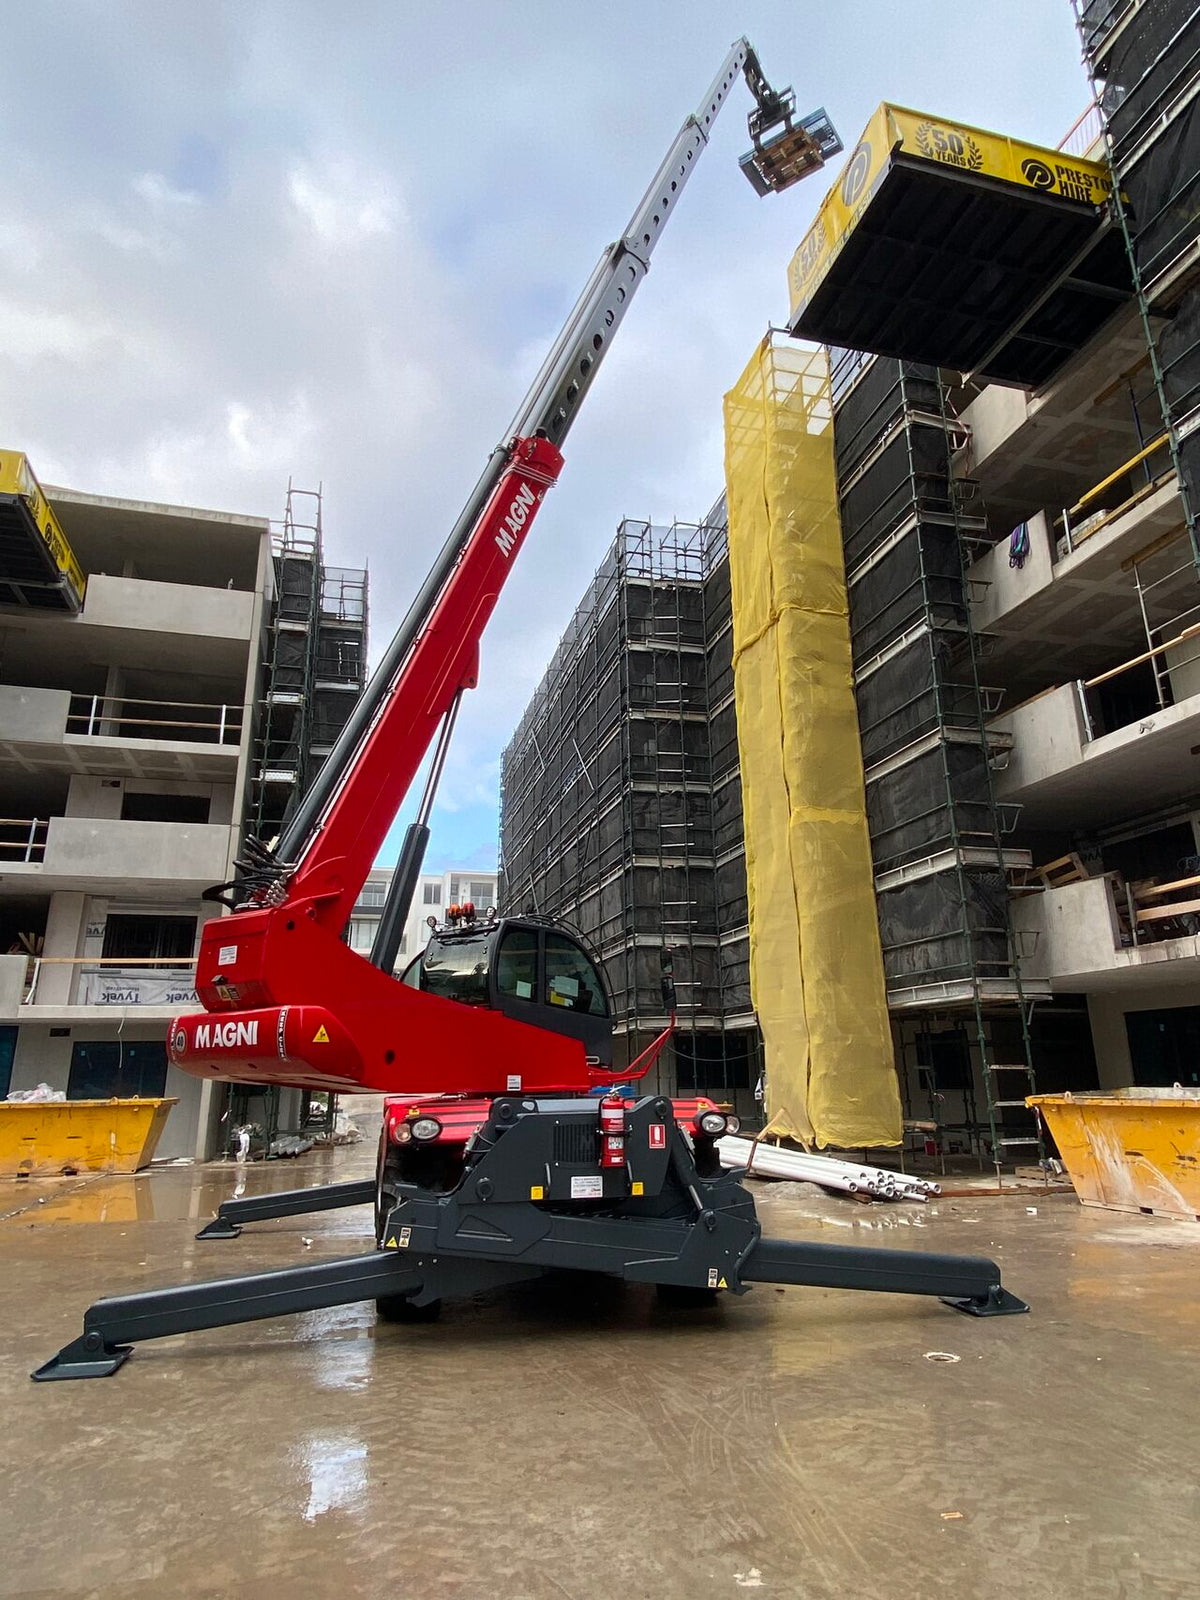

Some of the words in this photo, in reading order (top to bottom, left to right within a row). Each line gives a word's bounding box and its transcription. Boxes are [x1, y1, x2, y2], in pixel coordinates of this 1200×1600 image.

[931, 129, 964, 156] 50
[935, 149, 966, 166] YEARS
[1055, 164, 1113, 194] PRESTO
[1058, 179, 1092, 202] HIRE
[494, 482, 537, 558] MAGNI
[101, 991, 141, 1004] Tyvek
[195, 1020, 259, 1049] MAGNI
